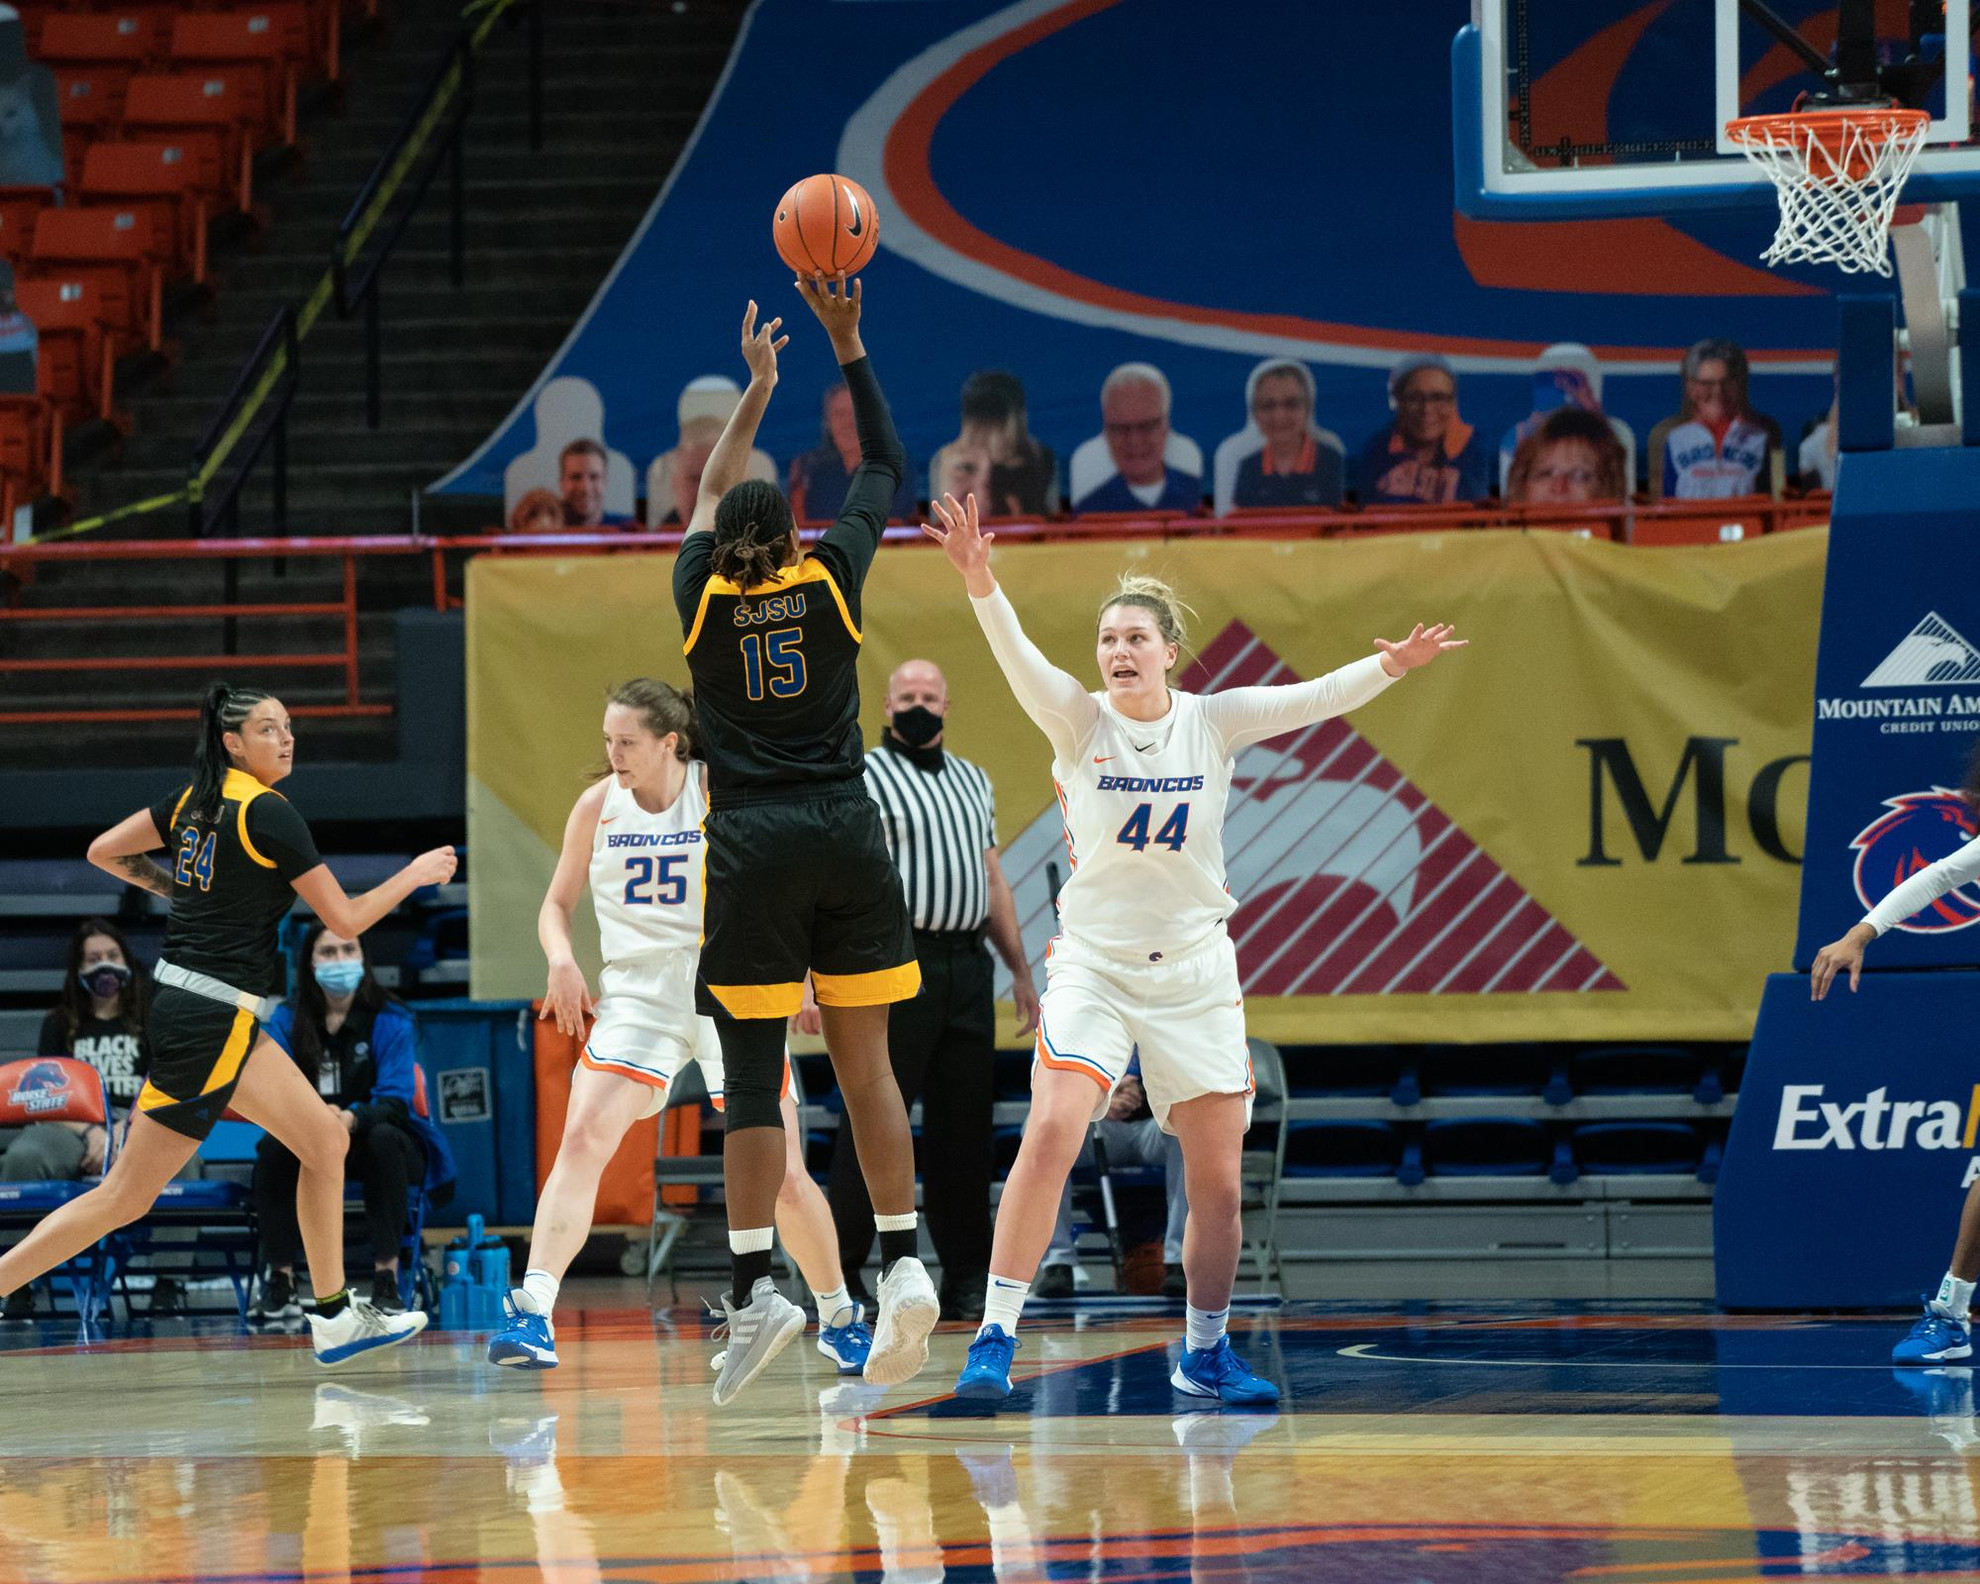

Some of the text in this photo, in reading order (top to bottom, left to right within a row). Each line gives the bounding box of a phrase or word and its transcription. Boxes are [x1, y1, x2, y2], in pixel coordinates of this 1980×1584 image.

[734, 593, 807, 627] SJSU
[740, 627, 807, 701] 15
[1818, 697, 1942, 719] MOUNTAIN
[1880, 721, 1935, 734] CREDIT
[1097, 775, 1204, 792] BRONCOS
[607, 829, 702, 848] BRONCOS
[1116, 802, 1190, 852] 44
[175, 826, 217, 891] 24
[623, 853, 689, 905] 25
[74, 1034, 140, 1058] BLACK
[28, 1095, 66, 1111] STATE
